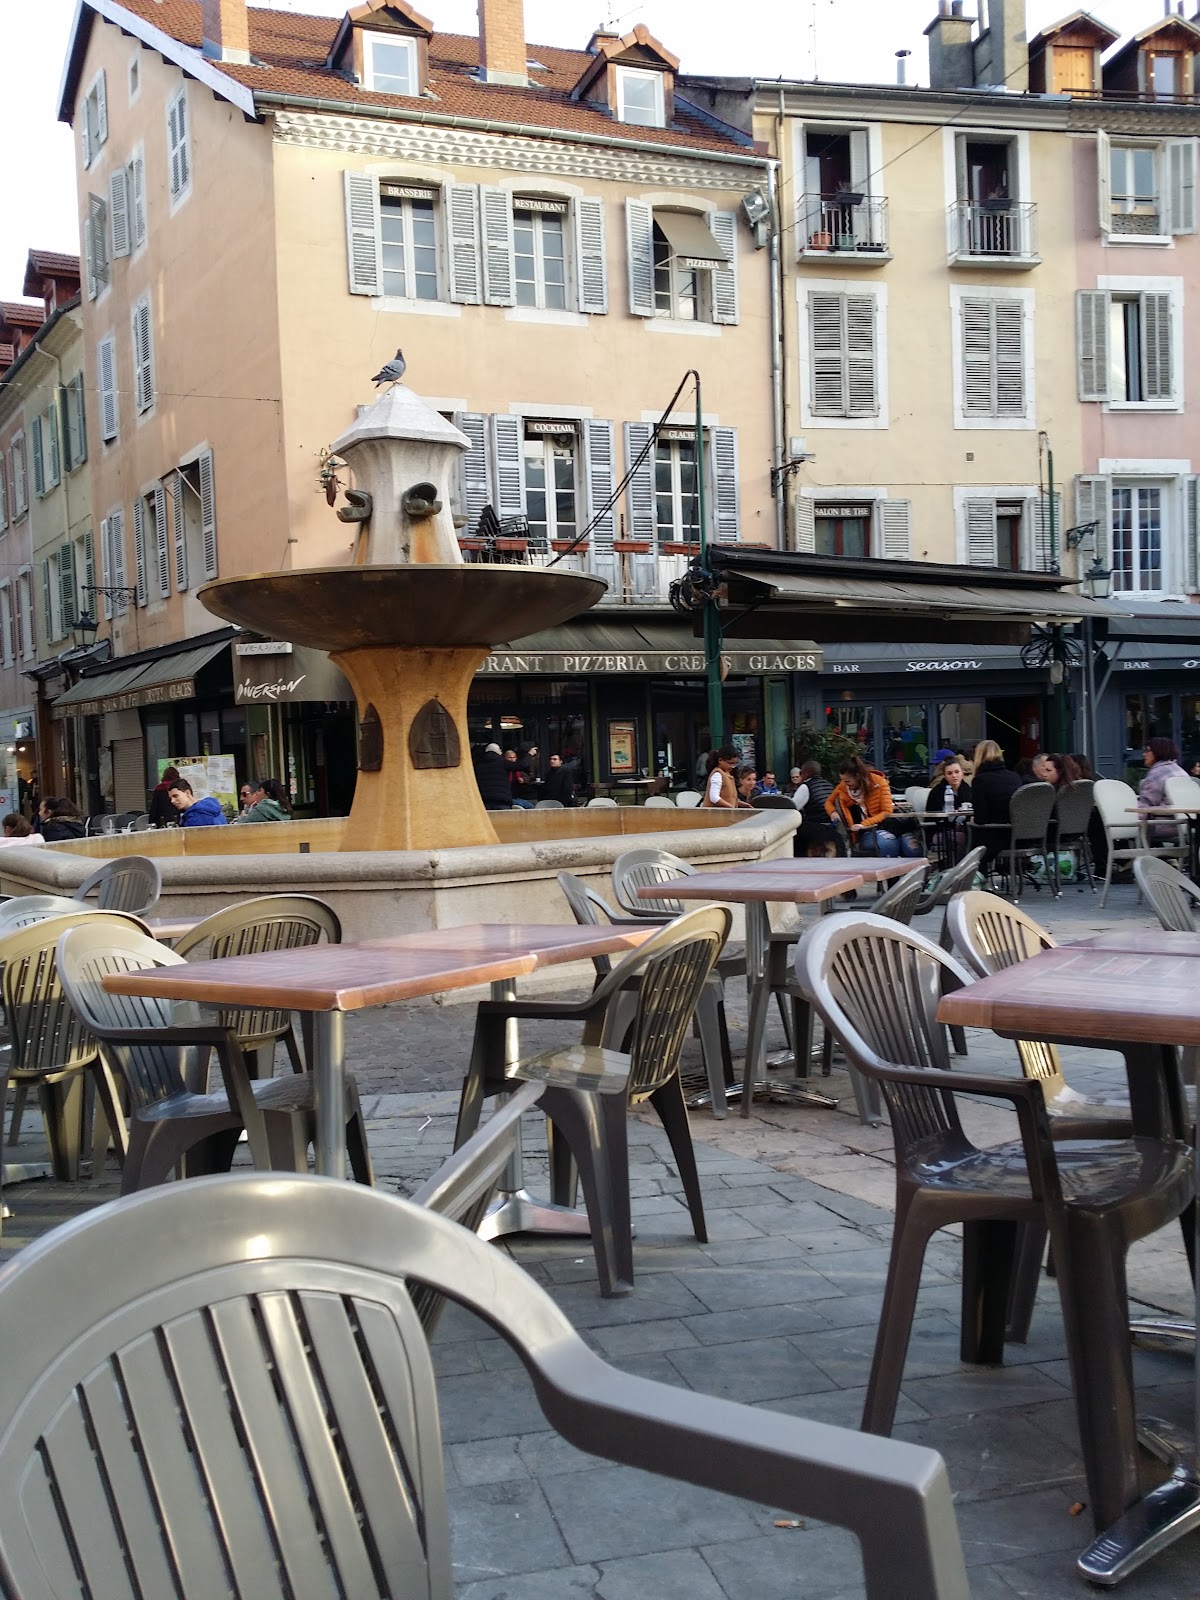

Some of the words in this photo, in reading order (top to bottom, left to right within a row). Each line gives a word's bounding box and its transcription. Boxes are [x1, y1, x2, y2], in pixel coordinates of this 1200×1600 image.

[387, 186, 433, 199] BRASSERIE
[514, 198, 567, 212] RESTAURANT
[685, 258, 720, 269] PIZZERIA
[668, 430, 699, 439] GLACIE
[814, 507, 839, 516] SALON
[840, 507, 852, 516] DE
[853, 507, 870, 516] THE
[562, 655, 649, 672] PIZZERIA
[664, 655, 732, 671] CRES
[749, 655, 816, 671] GLACES
[833, 664, 860, 673] BAR
[1123, 661, 1151, 669] BAR
